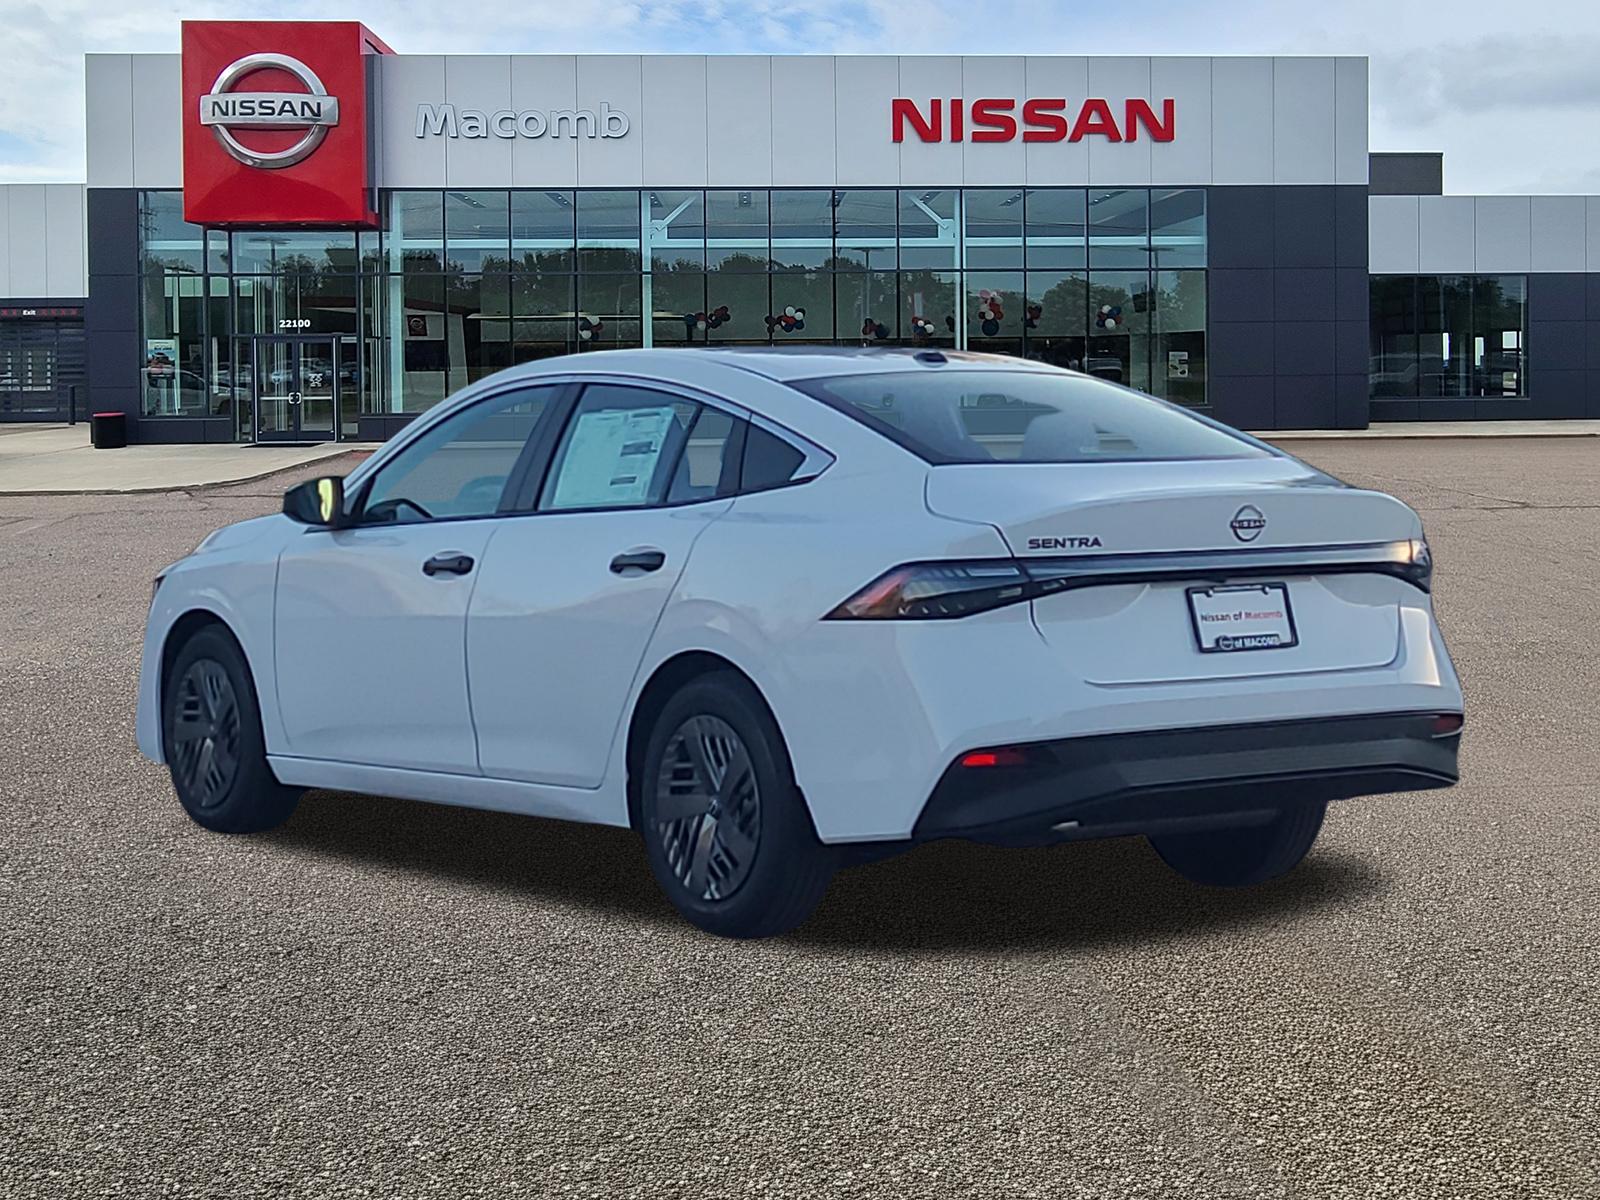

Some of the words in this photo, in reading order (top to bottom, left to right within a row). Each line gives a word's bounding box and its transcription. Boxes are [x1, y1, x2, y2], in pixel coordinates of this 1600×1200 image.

[211, 99, 321, 118] NISSAN
[415, 102, 630, 138] Macomb
[892, 98, 1176, 142] NISSAN
[279, 319, 311, 328] 22100
[1232, 520, 1266, 528] NISSAN
[1028, 536, 1102, 549] SENTRA
[1201, 612, 1231, 622] Nissan
[1233, 611, 1243, 621] of
[1244, 611, 1283, 620] Macomb
